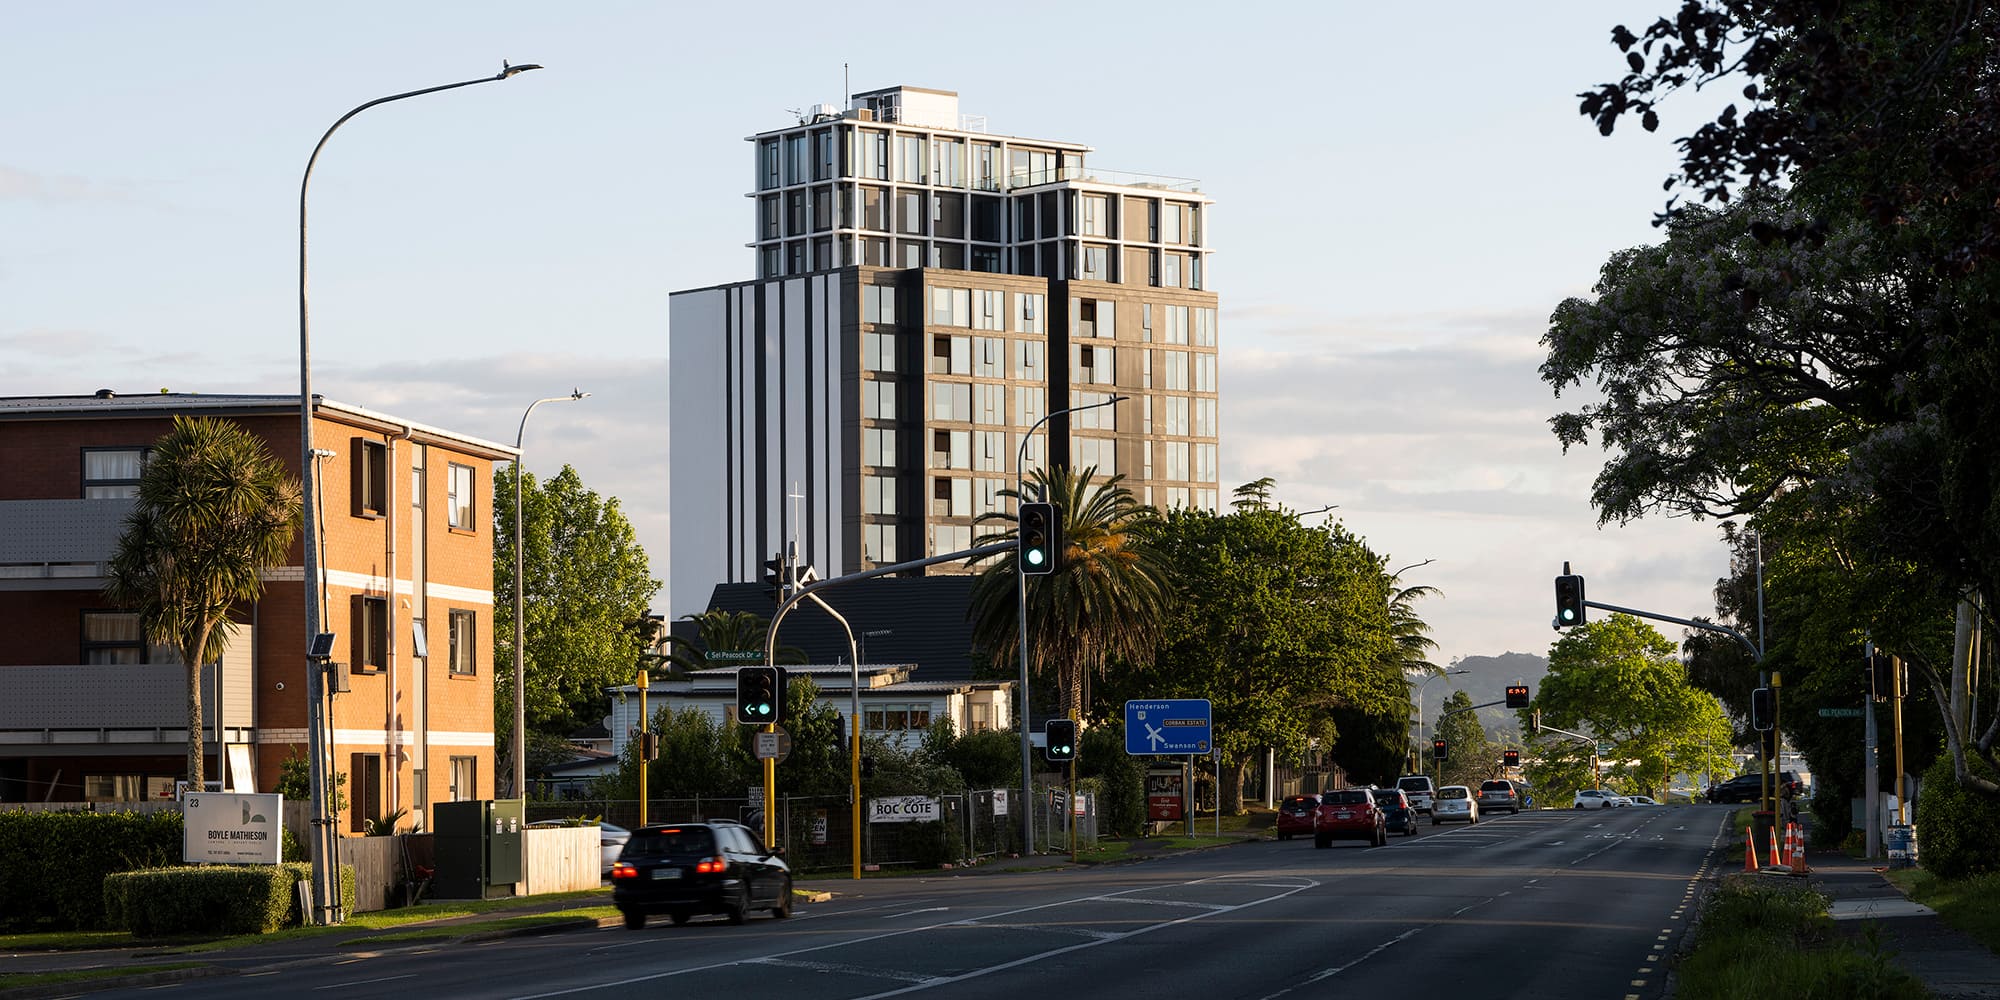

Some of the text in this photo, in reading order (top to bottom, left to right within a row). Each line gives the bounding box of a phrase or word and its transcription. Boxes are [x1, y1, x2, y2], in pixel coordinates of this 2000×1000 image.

[711, 651, 721, 659] Sel
[722, 651, 746, 659] Peacock
[190, 798, 199, 808] 23
[208, 830, 268, 841] BOYLE MATHIESON
